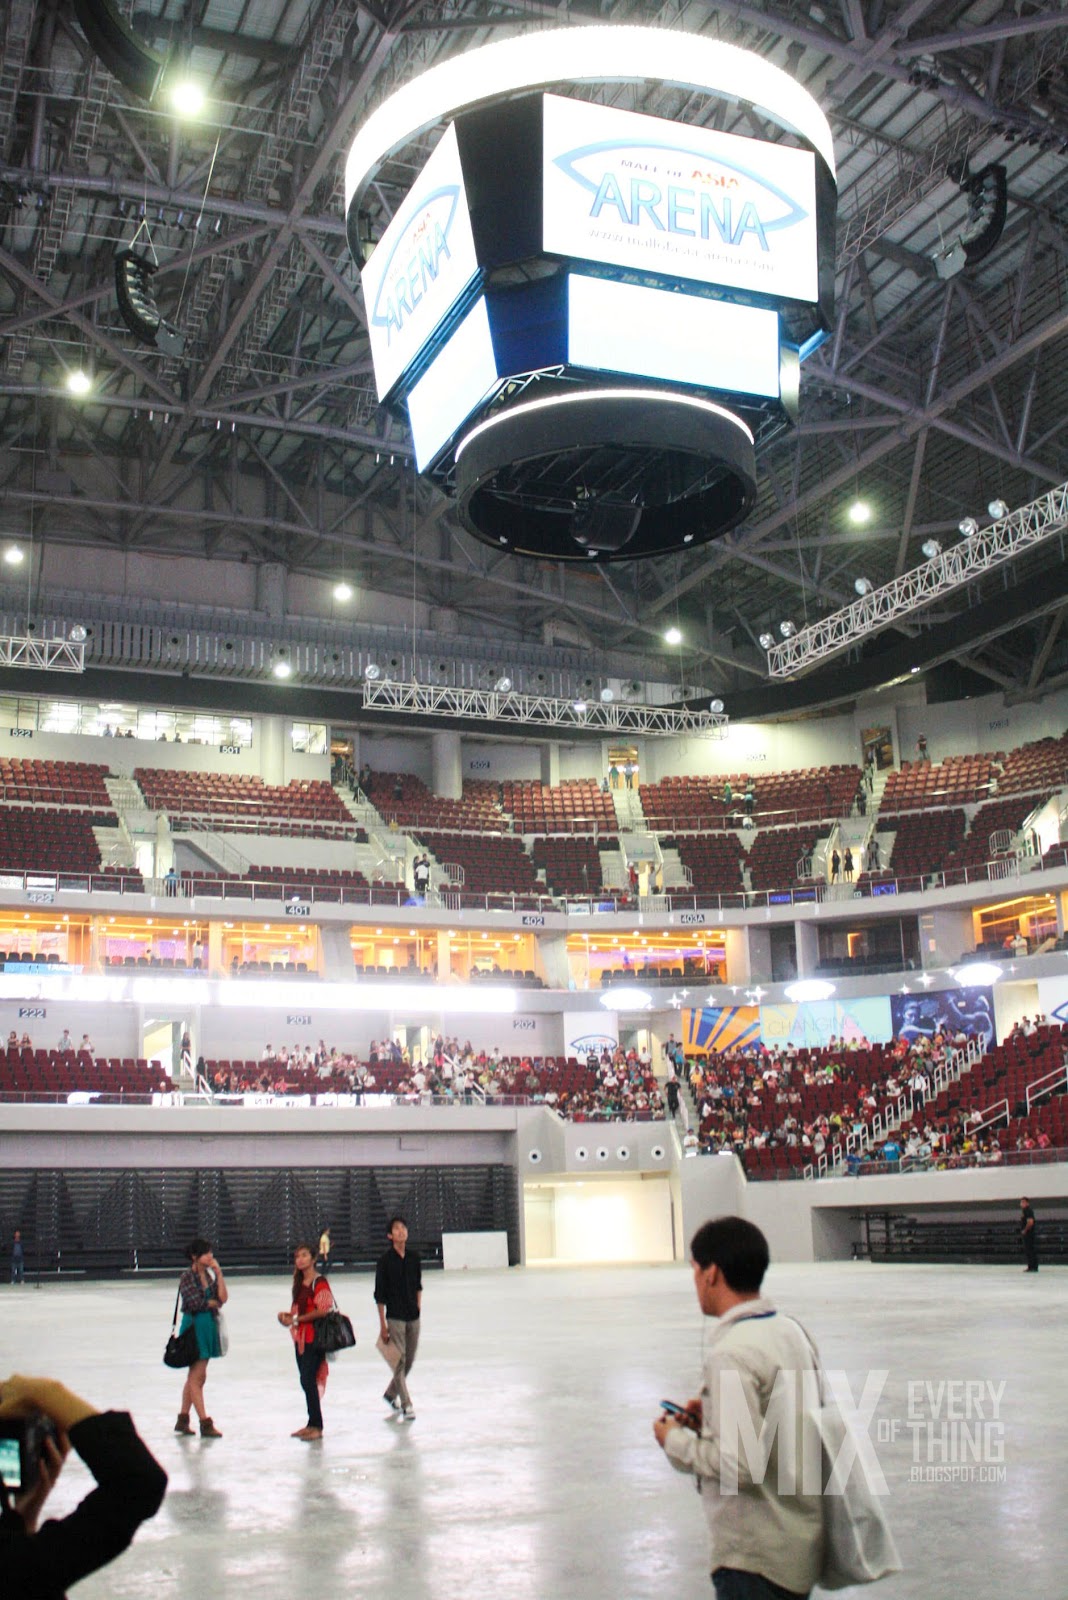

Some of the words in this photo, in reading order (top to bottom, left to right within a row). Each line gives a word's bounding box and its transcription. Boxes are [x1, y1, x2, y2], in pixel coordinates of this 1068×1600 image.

[690, 169, 739, 189] ASIA
[588, 171, 771, 253] ARENA
[386, 221, 452, 347] ARENA
[11, 728, 32, 738] 522
[221, 745, 239, 755] 501
[472, 761, 489, 770] 502
[29, 893, 54, 904] 422
[288, 905, 309, 916] 401
[524, 916, 543, 926] 402
[681, 914, 704, 924] 403A
[20, 1008, 45, 1019] 222
[289, 1015, 310, 1025] 201
[515, 1020, 535, 1030] 202
